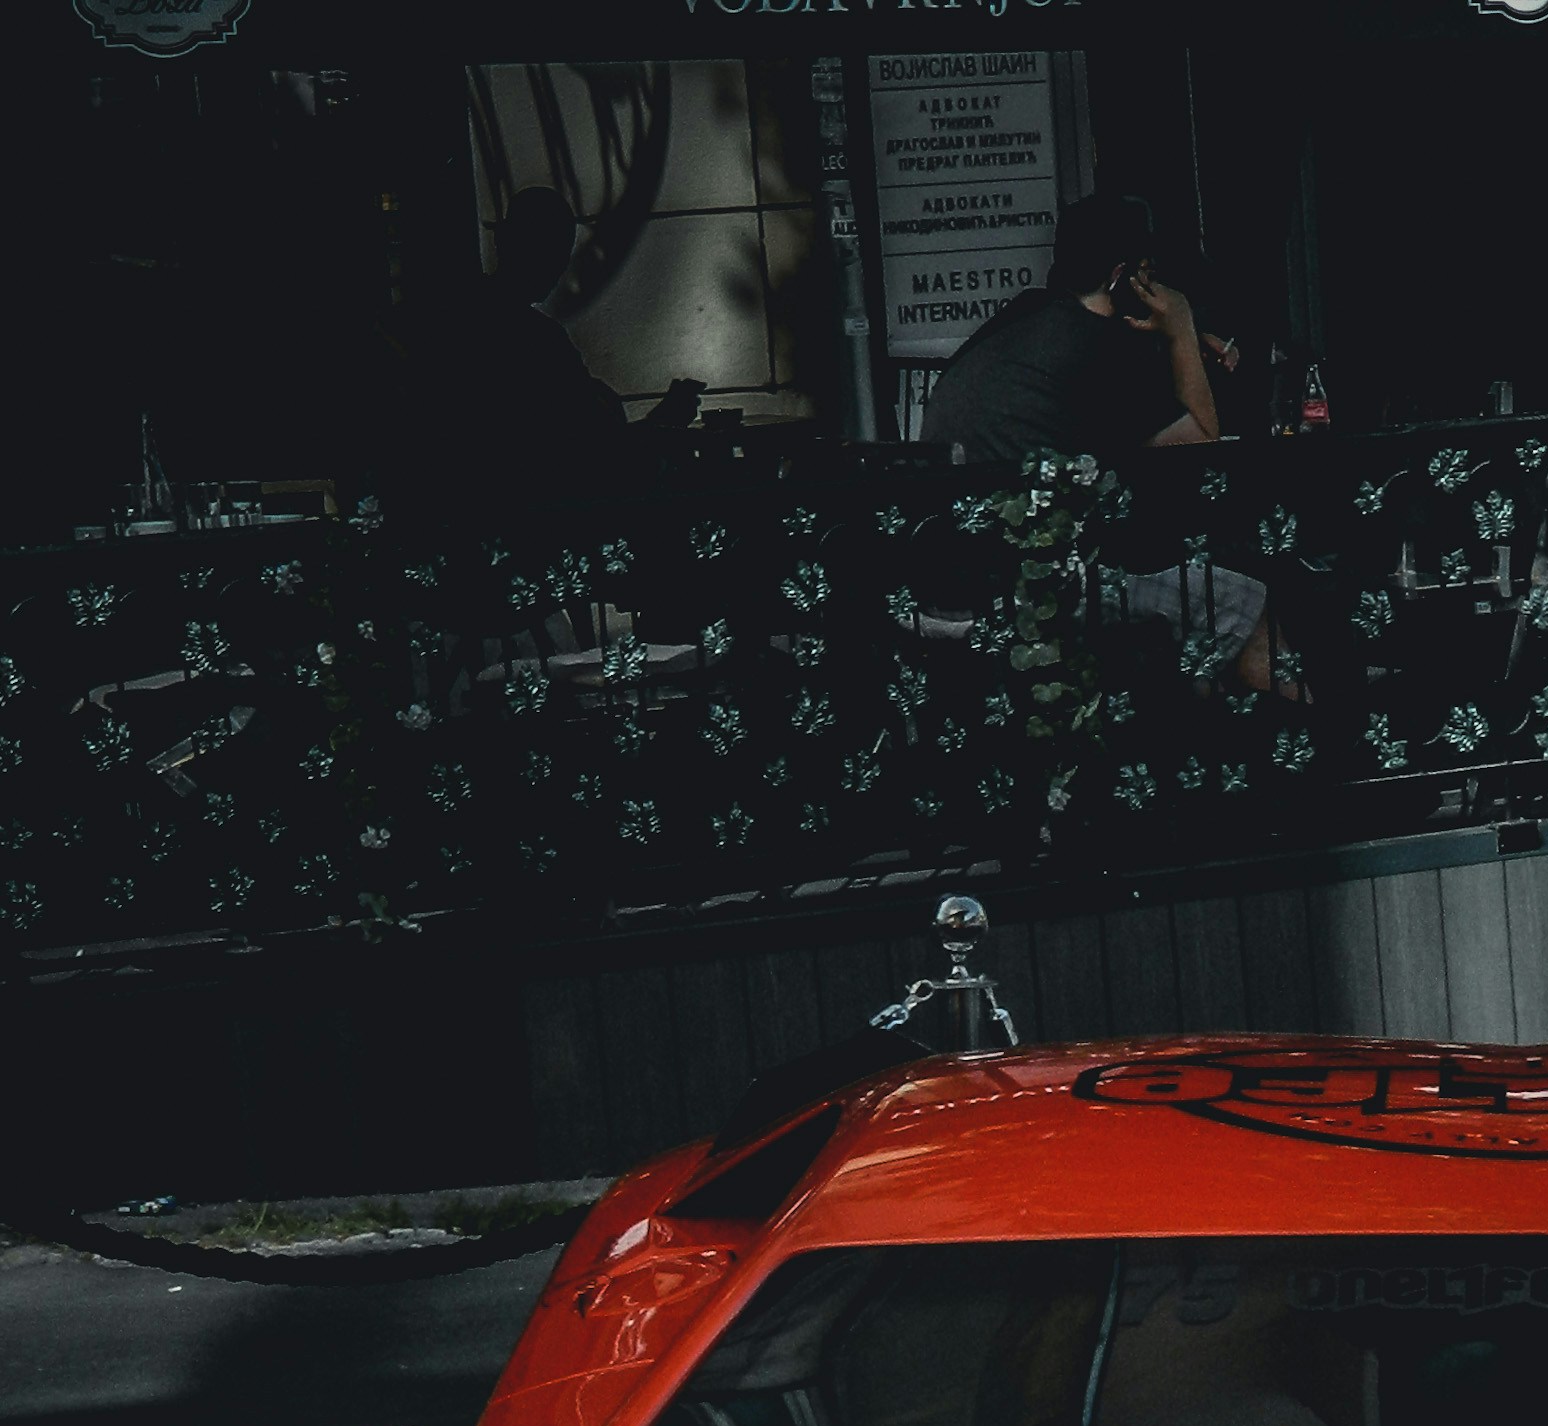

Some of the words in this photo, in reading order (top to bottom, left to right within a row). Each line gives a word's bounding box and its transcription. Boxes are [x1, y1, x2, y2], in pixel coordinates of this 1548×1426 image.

[879, 57, 977, 80] ВОЈИСЛАВ
[919, 95, 1001, 113] АДВОКАТ
[898, 155, 959, 171] ПРЕДРАГ
[922, 193, 1013, 213] АДВОКАТИ
[912, 267, 1032, 293] MAESTRO
